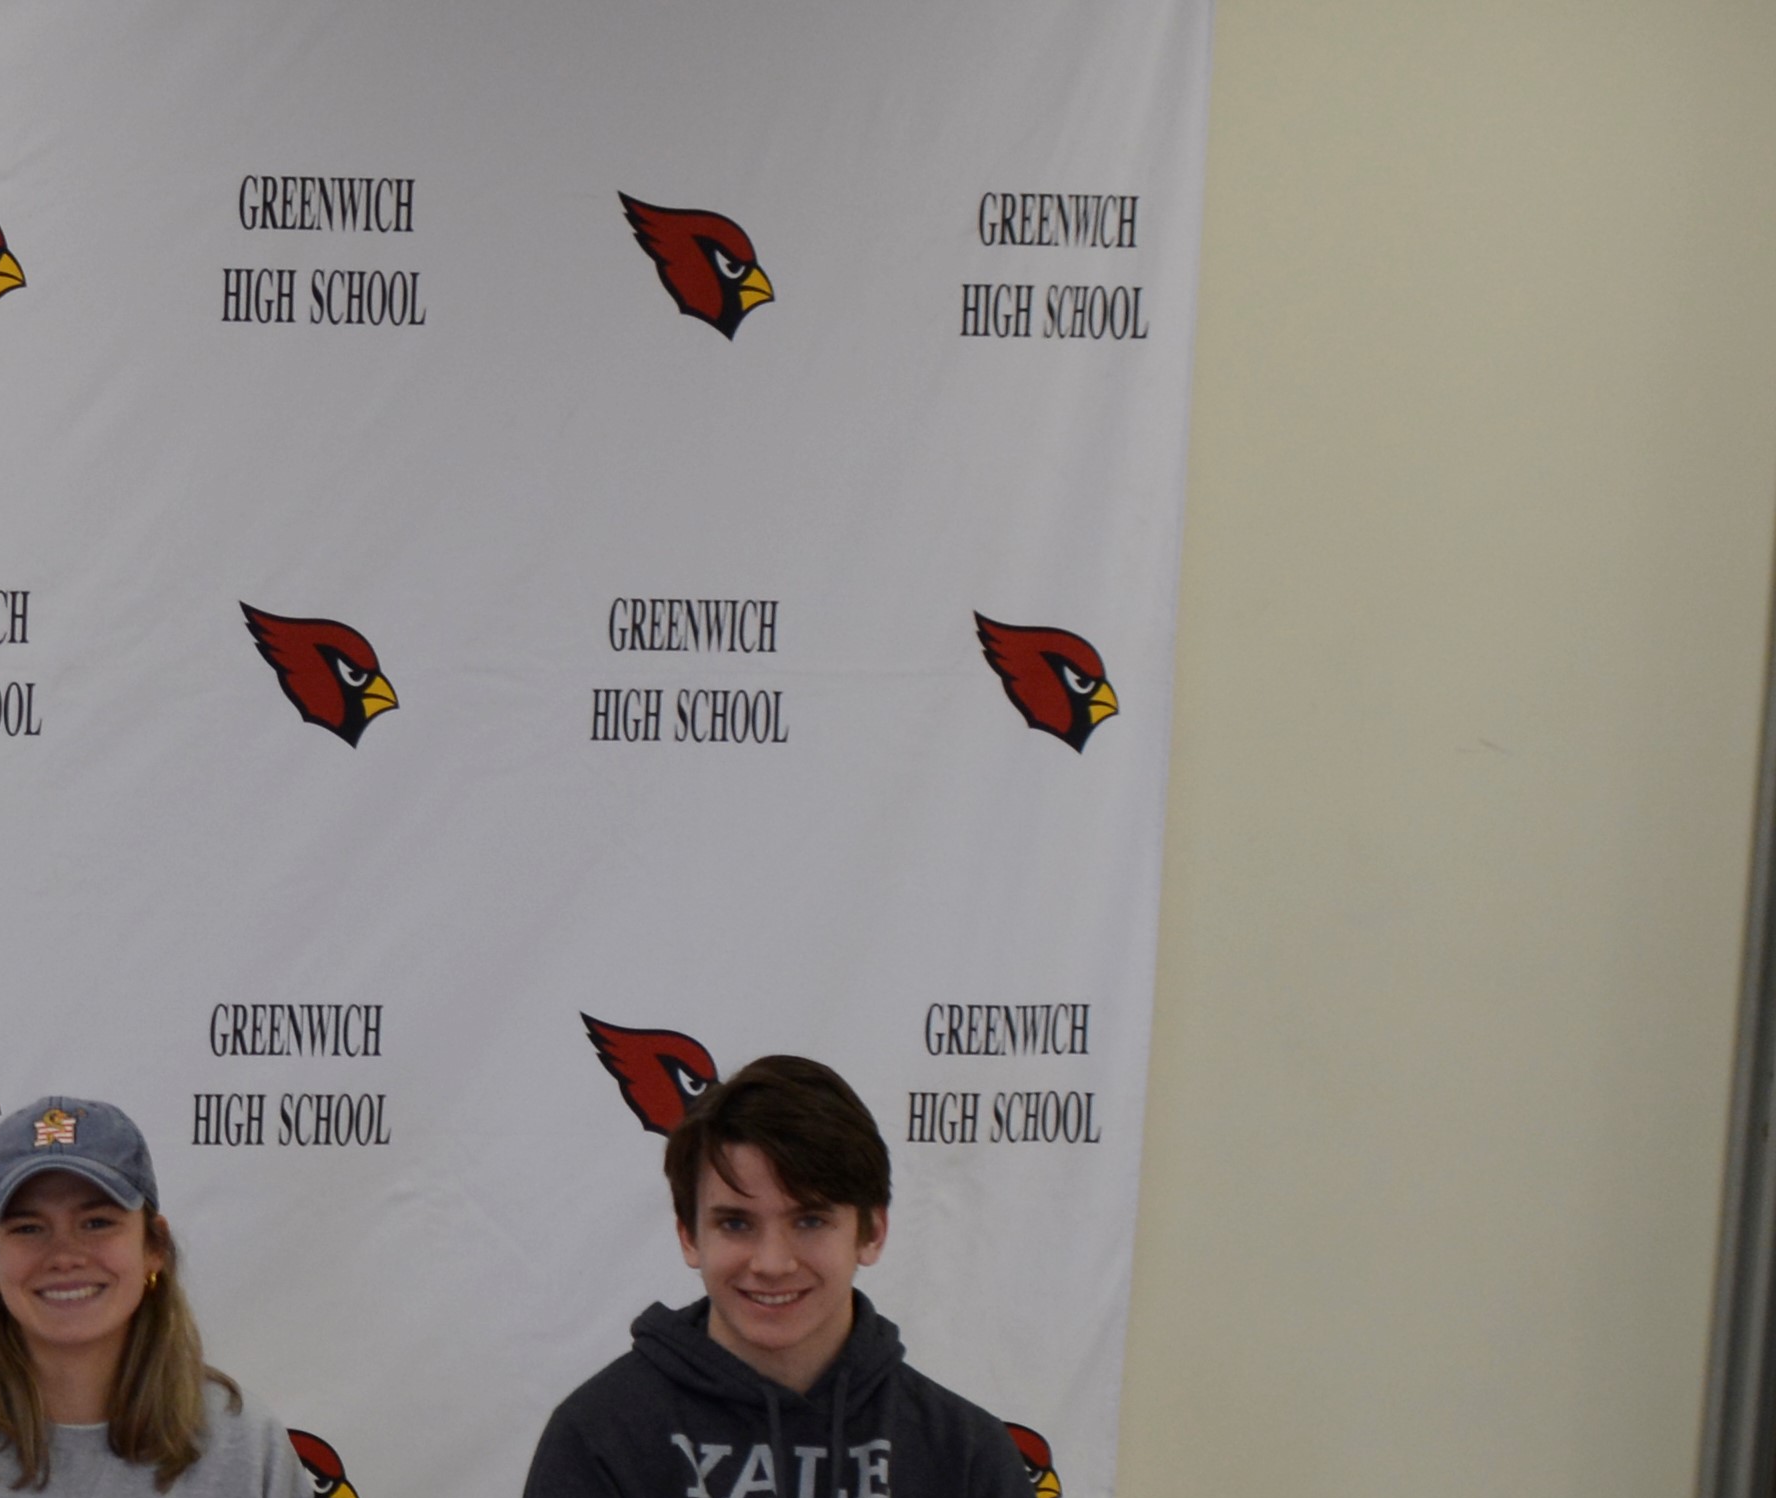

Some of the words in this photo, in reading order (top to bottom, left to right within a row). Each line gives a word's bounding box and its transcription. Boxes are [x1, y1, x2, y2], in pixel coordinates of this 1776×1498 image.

[239, 175, 415, 233] GREENWICH
[979, 192, 1138, 248] GREENWICH
[222, 269, 296, 323] HIGH
[311, 269, 425, 326] SCHOOL
[961, 284, 1034, 338] HIGH
[1047, 286, 1147, 340] SCHOOL
[609, 598, 778, 653] GREENWICH
[591, 689, 663, 742] HIGH
[675, 689, 787, 743] SCHOOL
[210, 1004, 382, 1057] GREENWICH
[925, 1003, 1089, 1055] GREENWICH
[192, 1094, 265, 1146] HIGH
[279, 1094, 390, 1146] SCHOOL
[907, 1092, 980, 1144] HIGH
[994, 1091, 1100, 1143] SCHOOL
